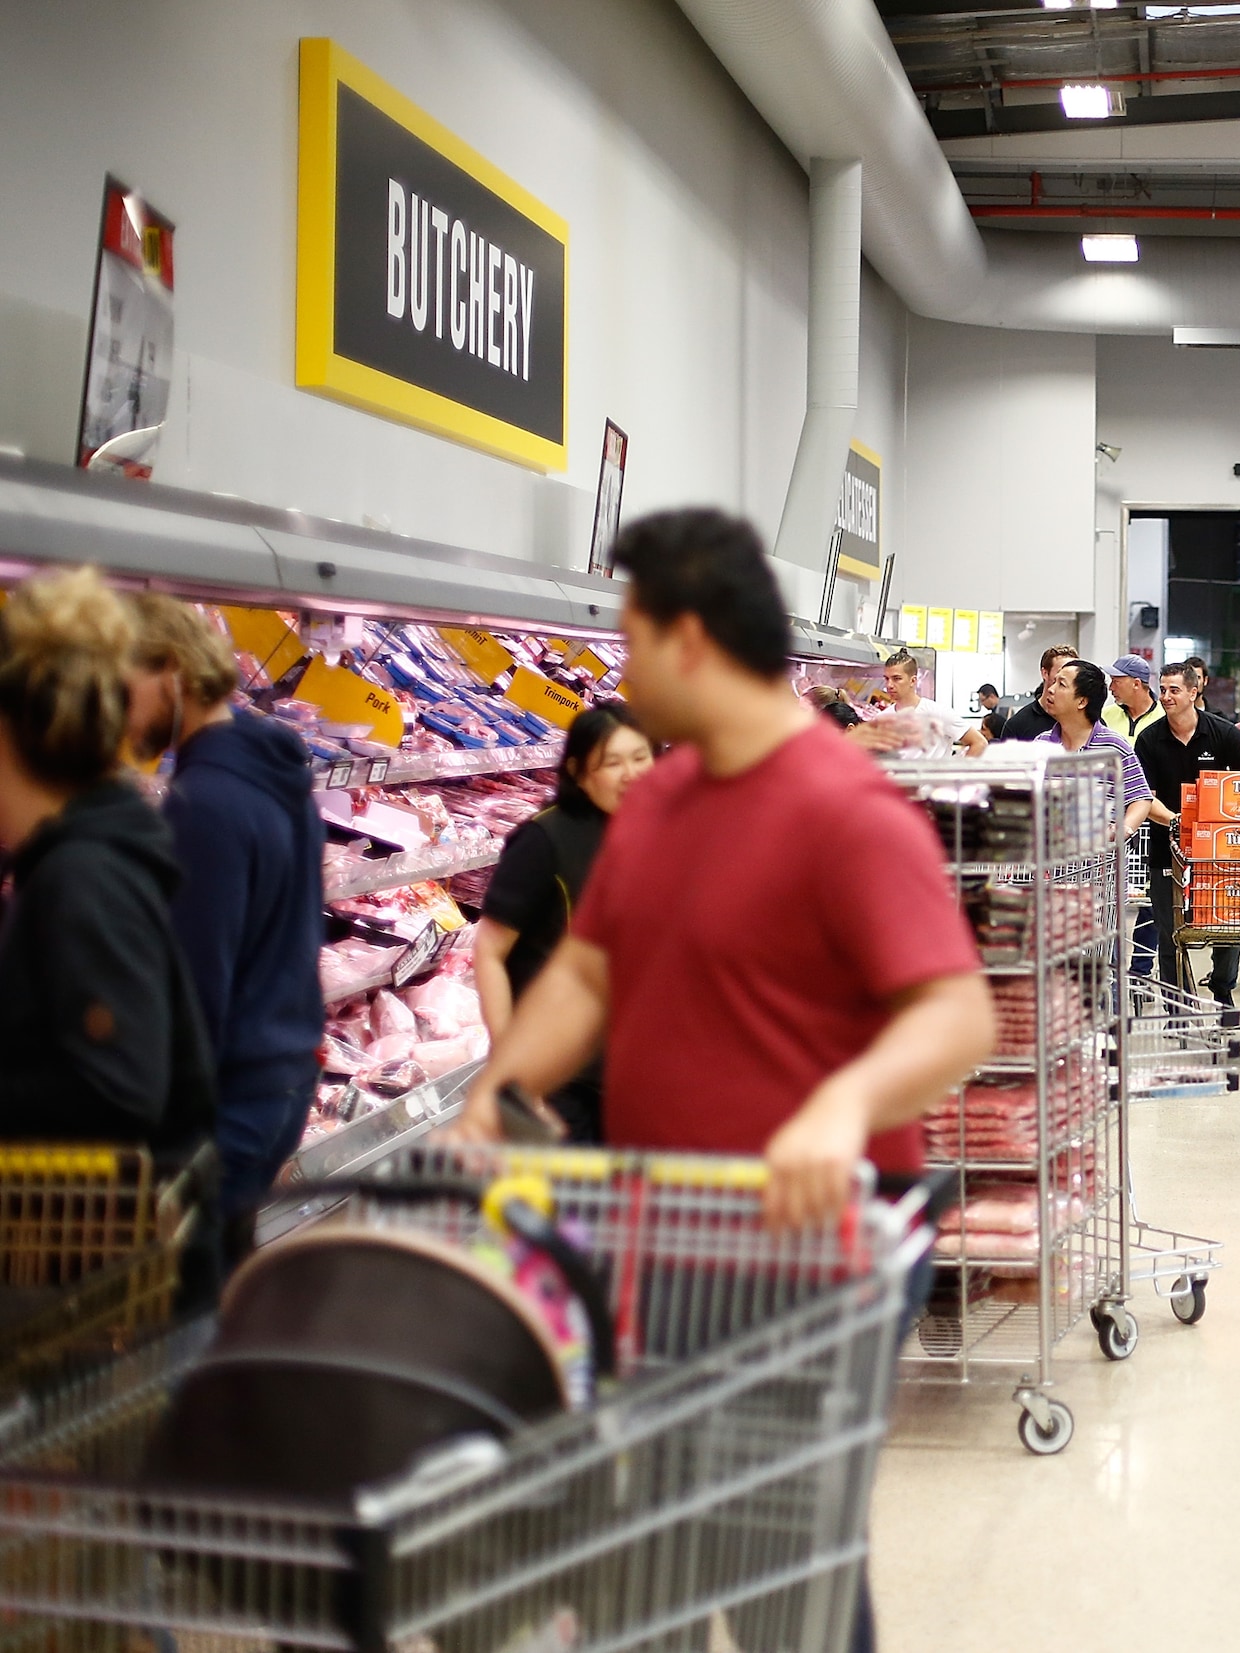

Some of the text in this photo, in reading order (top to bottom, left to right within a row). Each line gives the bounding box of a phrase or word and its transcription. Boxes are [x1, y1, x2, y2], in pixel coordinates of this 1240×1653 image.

[387, 178, 533, 381] BUTCHERY
[365, 692, 390, 714] Pork
[544, 685, 579, 711] Trimpork
